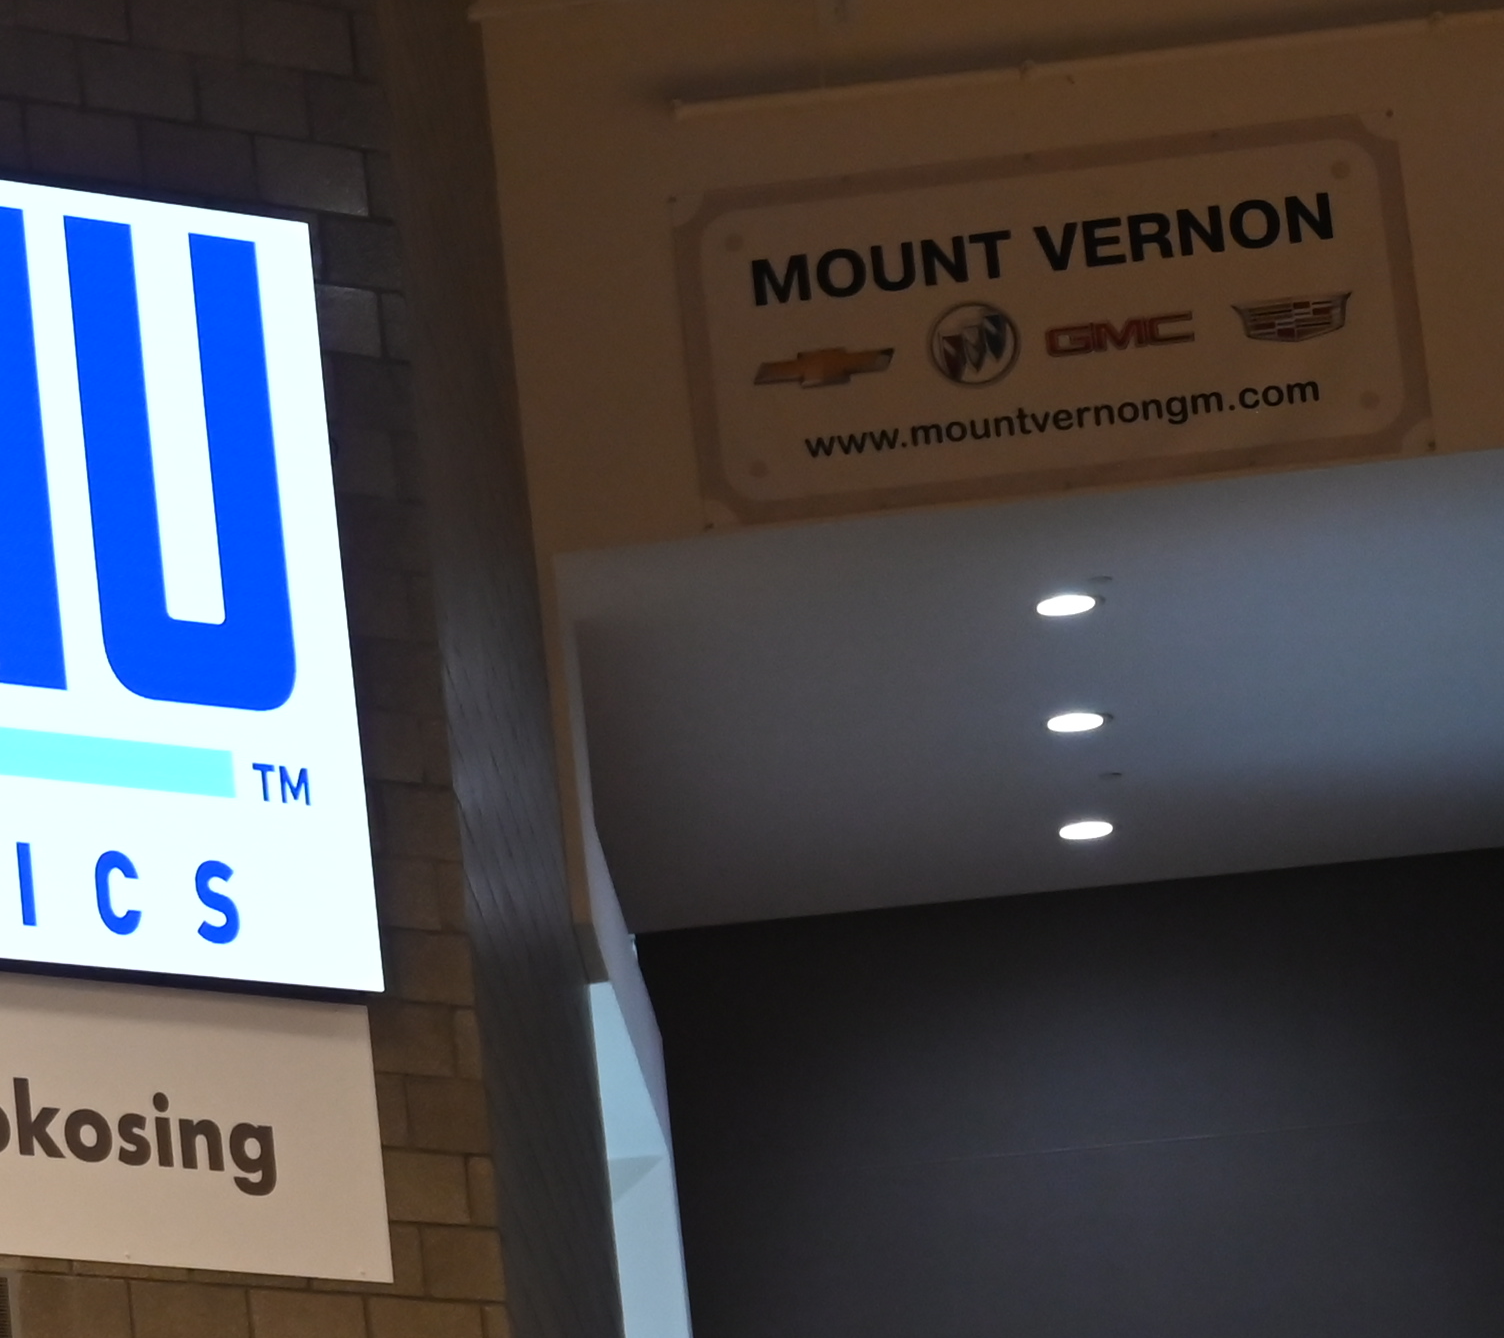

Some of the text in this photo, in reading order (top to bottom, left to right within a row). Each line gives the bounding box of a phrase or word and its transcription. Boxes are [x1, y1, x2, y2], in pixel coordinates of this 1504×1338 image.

[750, 191, 1336, 308] MOUNT VERNON
[1045, 309, 1197, 359] GMC
[805, 378, 1321, 459] www.mountvernongm.com
[252, 762, 311, 806] TM
